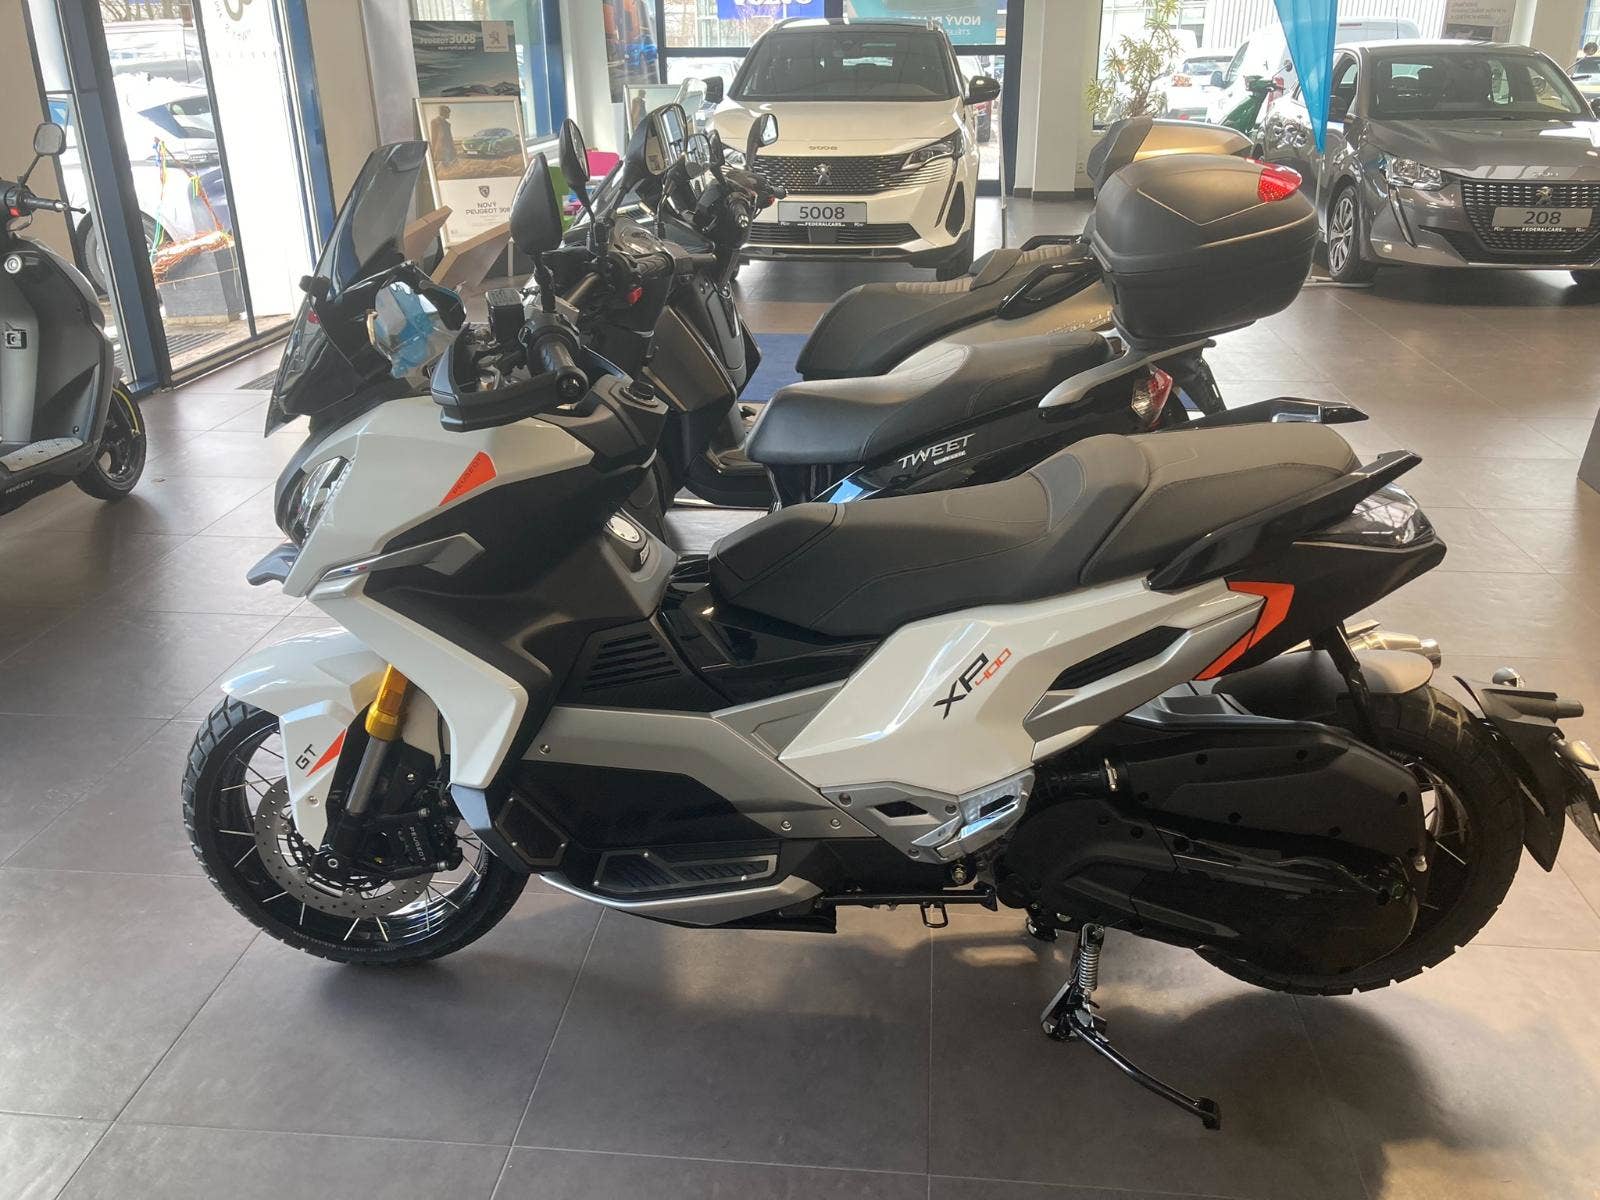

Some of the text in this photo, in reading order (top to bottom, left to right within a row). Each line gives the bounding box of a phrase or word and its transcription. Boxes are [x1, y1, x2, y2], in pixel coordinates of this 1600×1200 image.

[447, 33, 477, 44] 3008
[799, 206, 846, 220] 5008
[1523, 211, 1562, 225] 208
[897, 432, 977, 469] TWEET
[295, 743, 316, 770] GT
[409, 826, 426, 861] PEUGEOT
